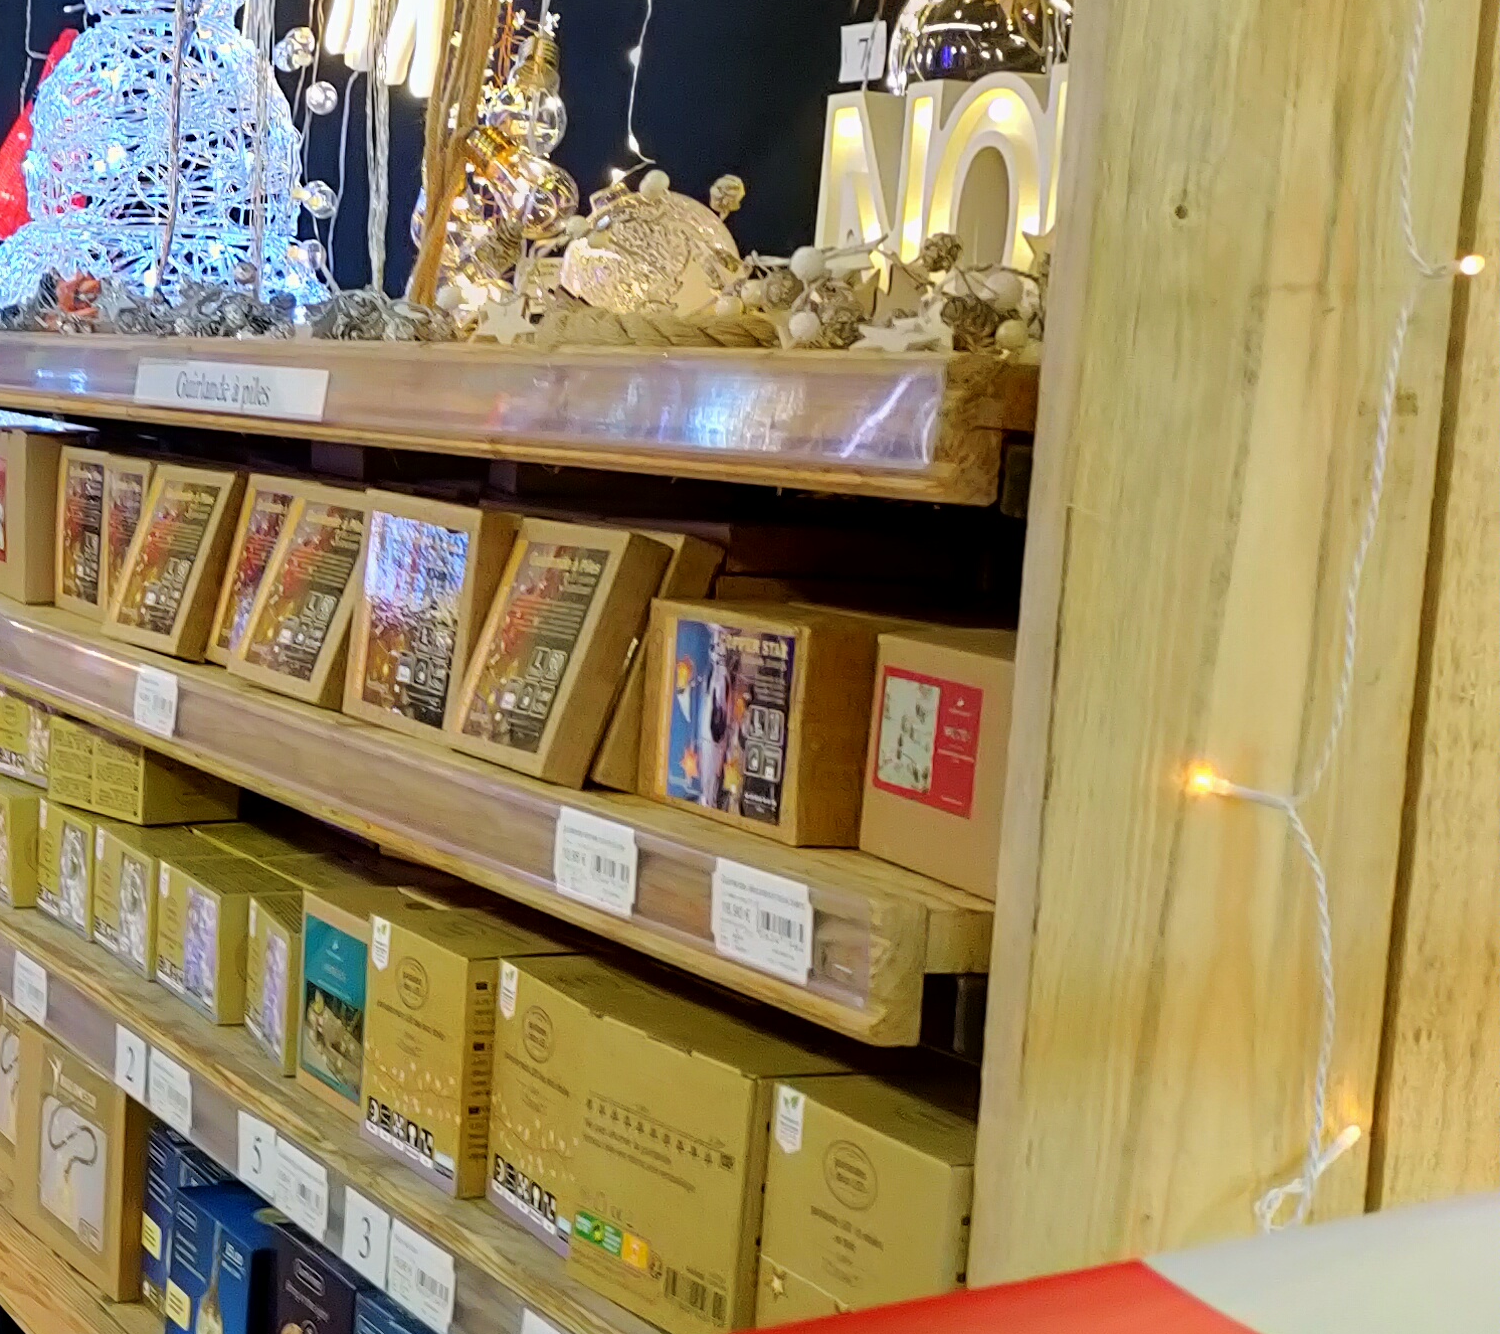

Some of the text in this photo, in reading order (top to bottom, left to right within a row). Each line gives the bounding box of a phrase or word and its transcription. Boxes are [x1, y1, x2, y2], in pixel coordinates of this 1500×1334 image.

[176, 371, 230, 402] Guirlande
[241, 376, 272, 411] piles
[125, 1046, 136, 1084] 2
[251, 1135, 264, 1176] 5
[358, 1216, 372, 1260] 3
